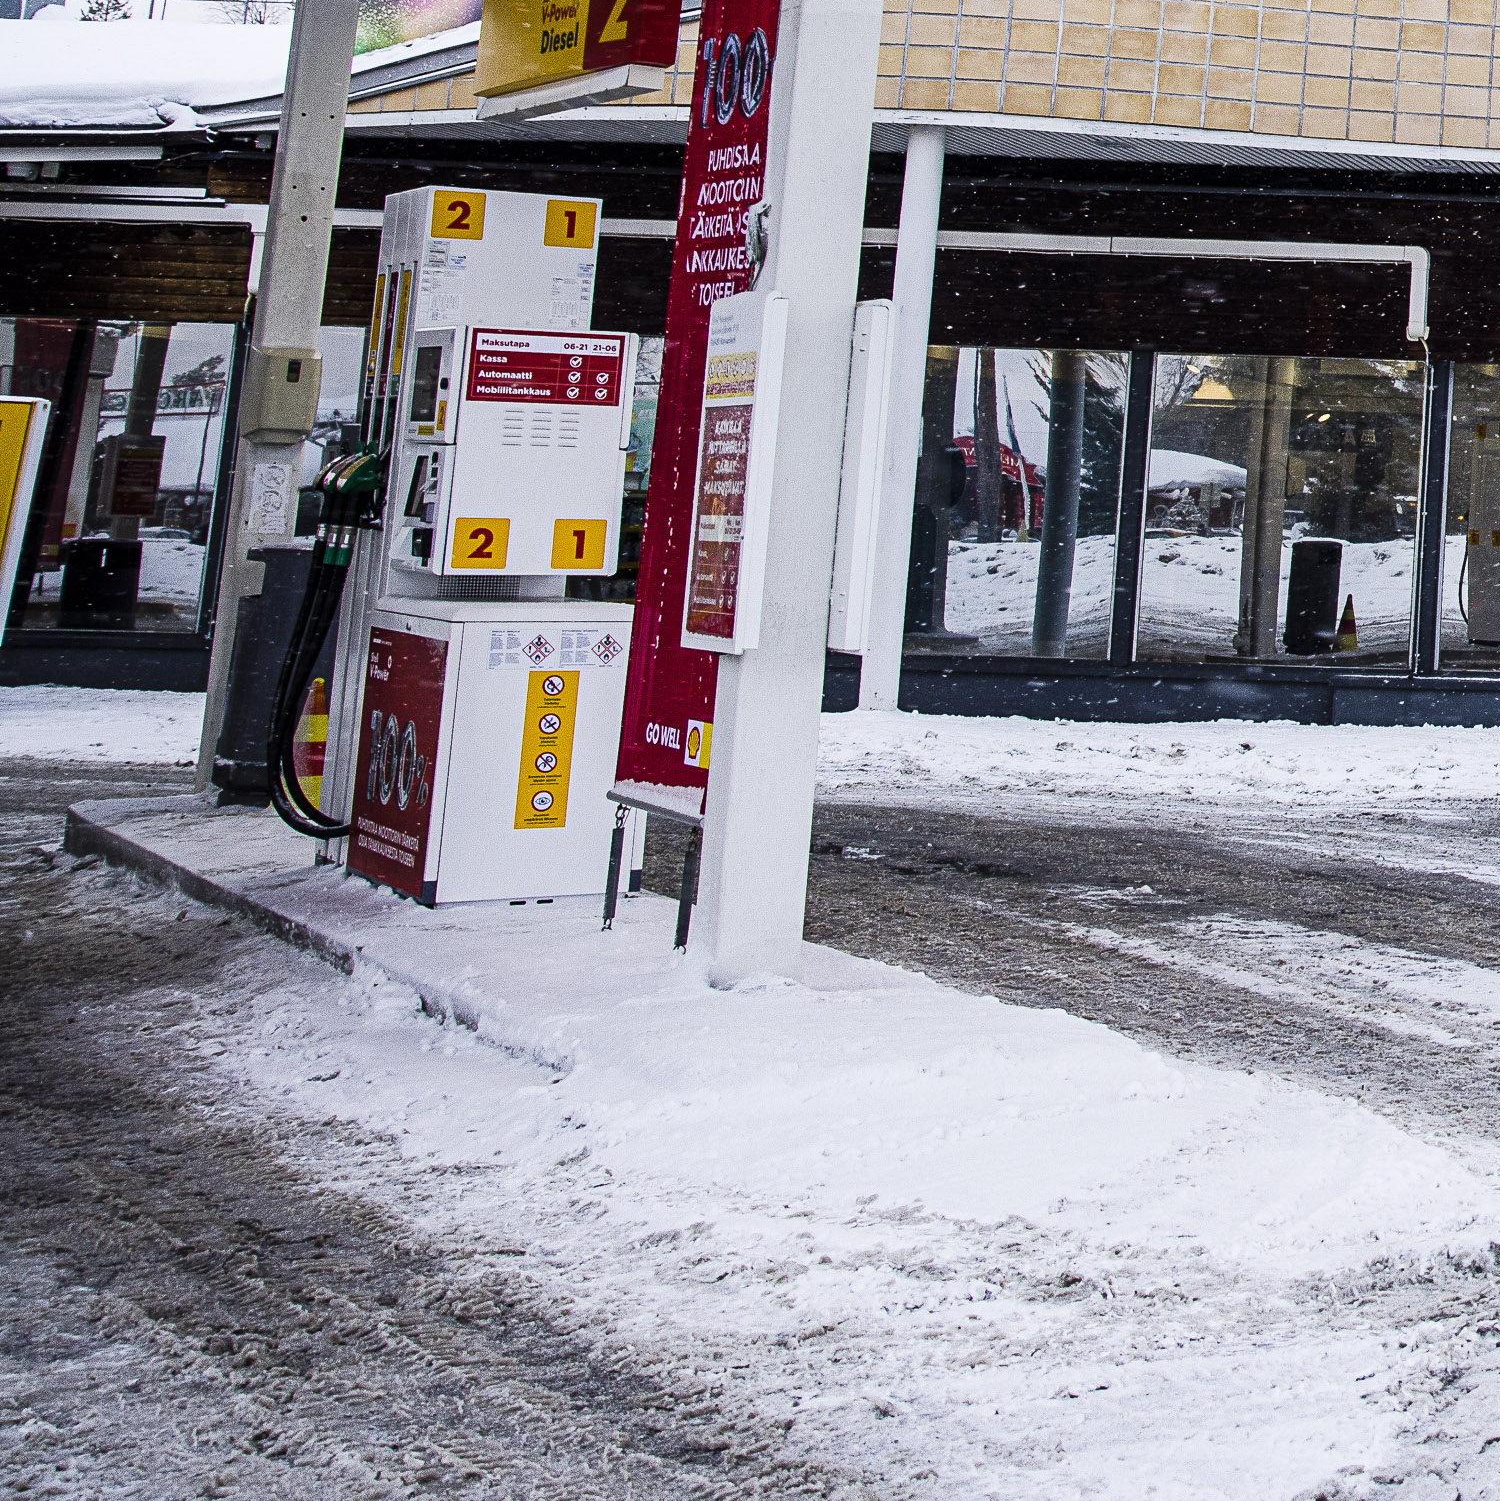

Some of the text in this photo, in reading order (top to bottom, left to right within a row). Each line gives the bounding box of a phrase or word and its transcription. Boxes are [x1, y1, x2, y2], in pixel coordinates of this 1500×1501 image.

[540, 21, 579, 55] Diesel
[446, 200, 471, 230] 2
[564, 210, 577, 239] 1
[481, 338, 617, 352] Maksutapa 06-21 21-06
[479, 355, 508, 364] Kassa
[478, 370, 533, 380] Automaatti
[476, 385, 551, 396] Mobiilitankkaus
[467, 527, 494, 559] 2
[572, 530, 585, 559] 1
[646, 722, 680, 750] GO WELL
